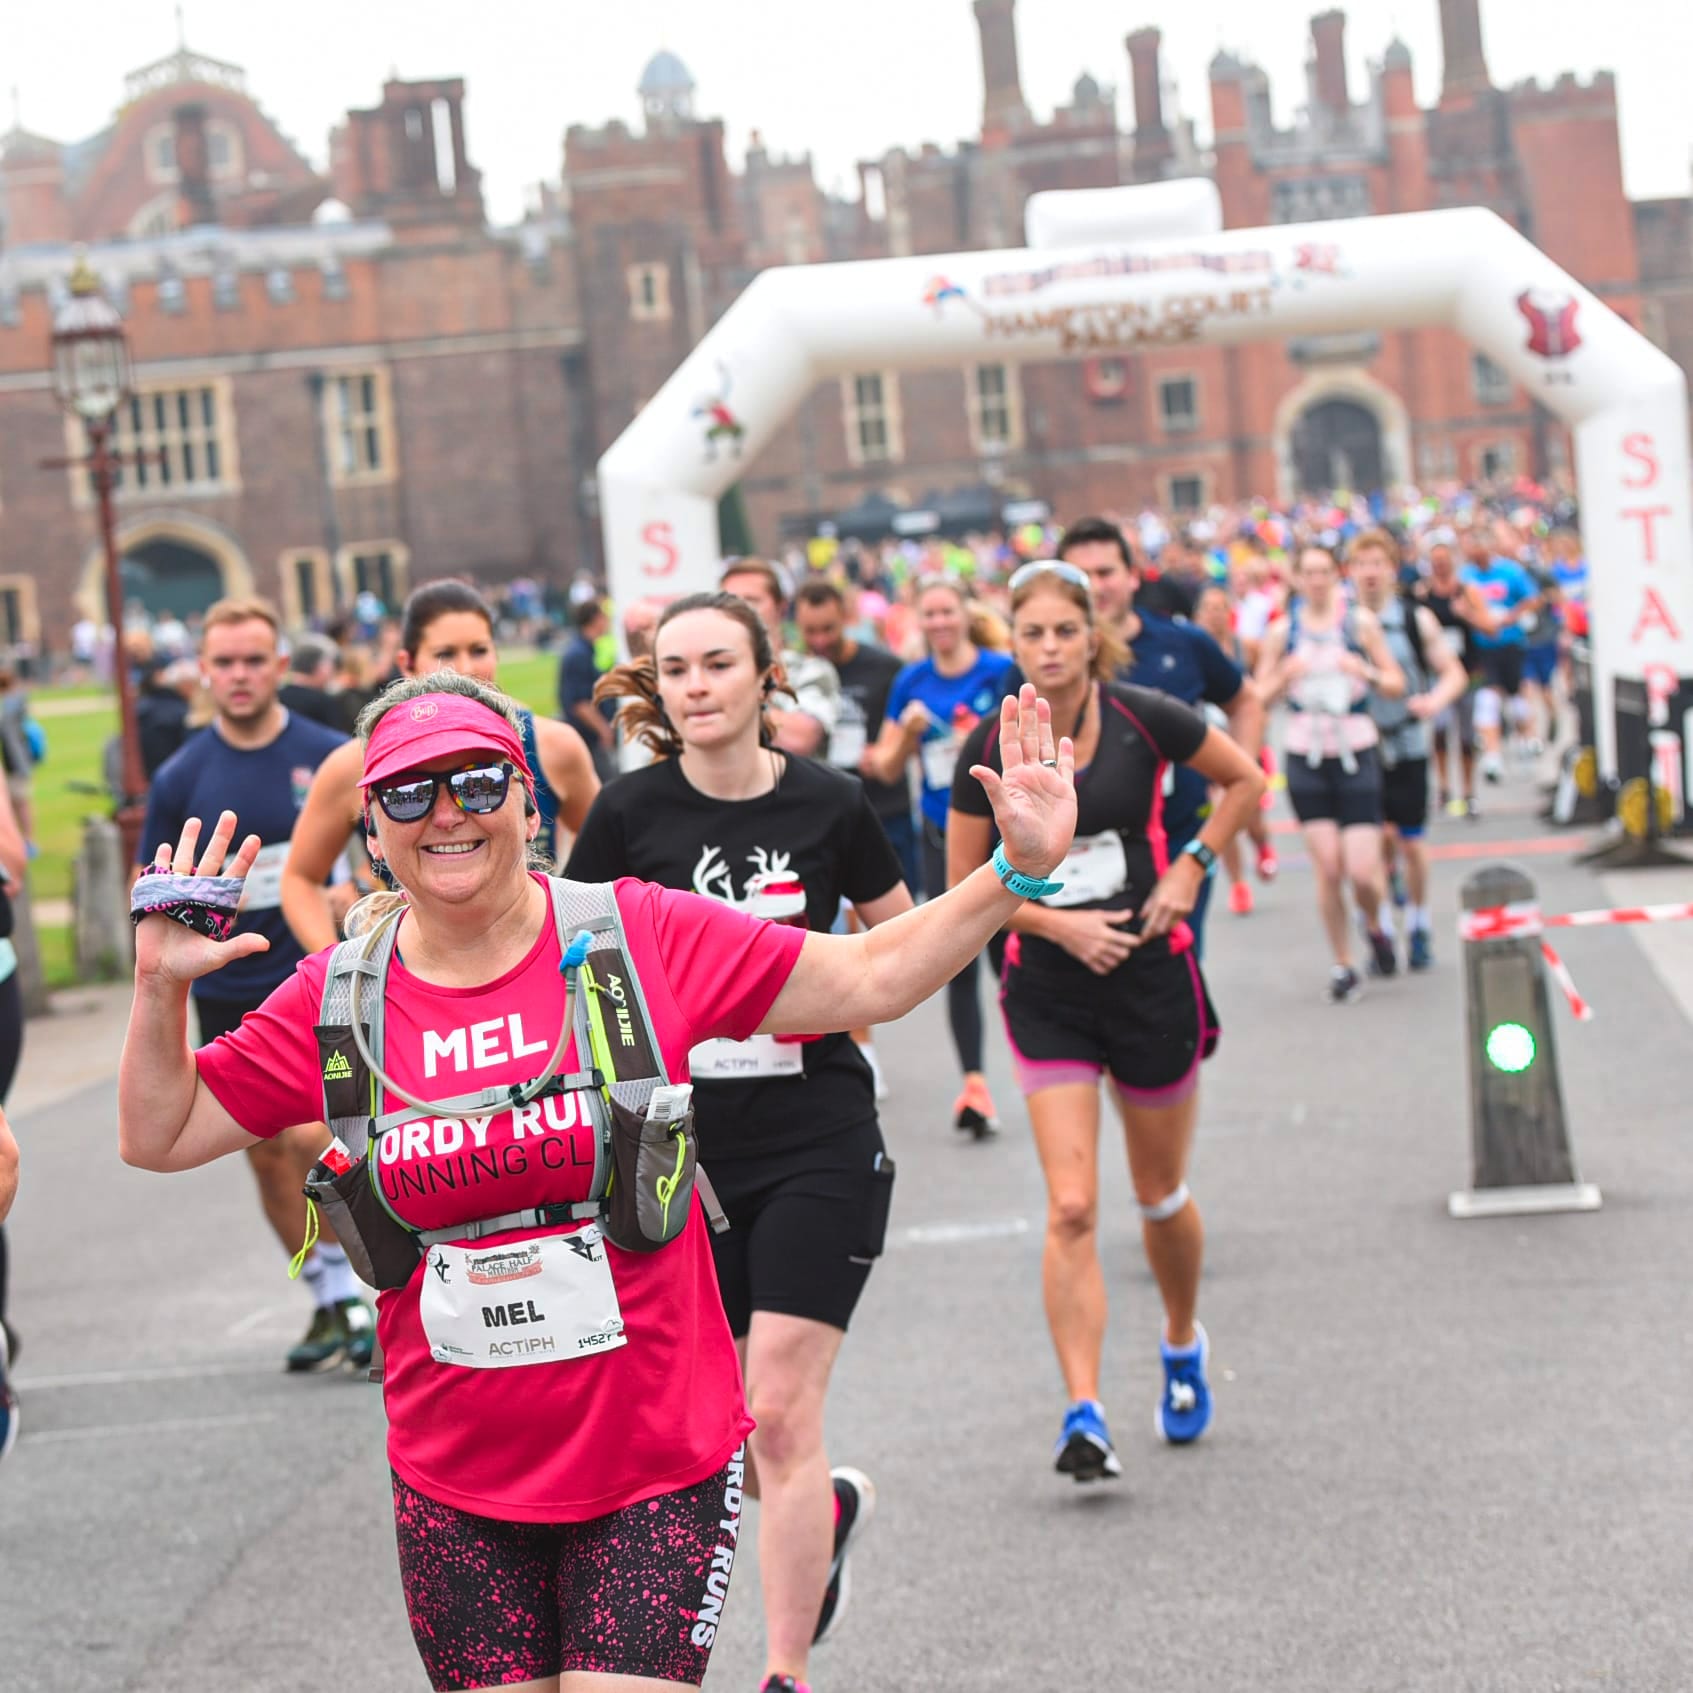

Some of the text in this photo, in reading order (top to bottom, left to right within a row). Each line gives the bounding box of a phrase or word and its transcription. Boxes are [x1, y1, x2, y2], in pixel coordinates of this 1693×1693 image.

[984, 287, 1272, 337] HAMPTON COURT
[423, 1012, 548, 1079] MEL
[482, 1300, 545, 1328] MEL
[691, 1545, 734, 1649] RUNS
